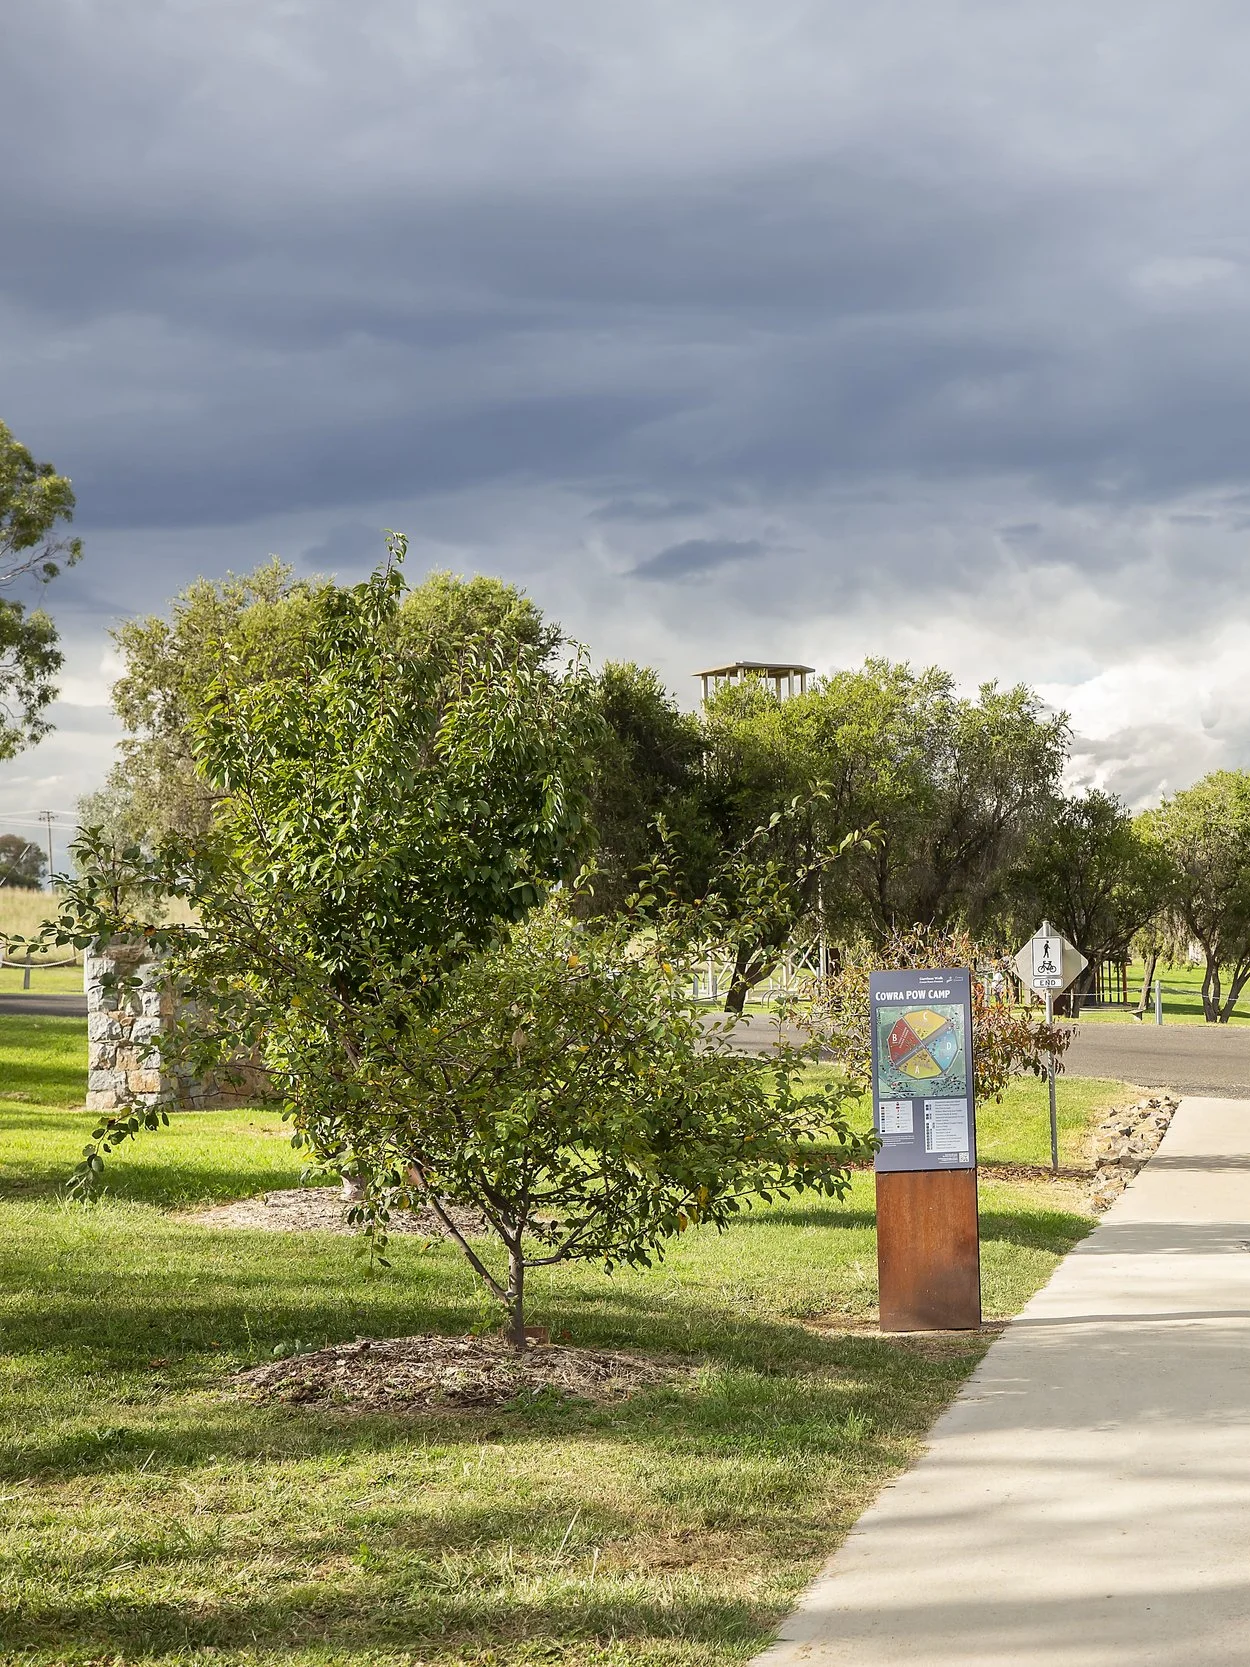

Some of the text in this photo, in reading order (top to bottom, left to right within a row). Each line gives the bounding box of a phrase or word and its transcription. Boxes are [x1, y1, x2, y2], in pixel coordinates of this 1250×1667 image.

[875, 989, 950, 1001] COWRA POW CAMP
[923, 1012, 928, 1020] C
[892, 1033, 897, 1042] B
[915, 1066, 920, 1074] A
